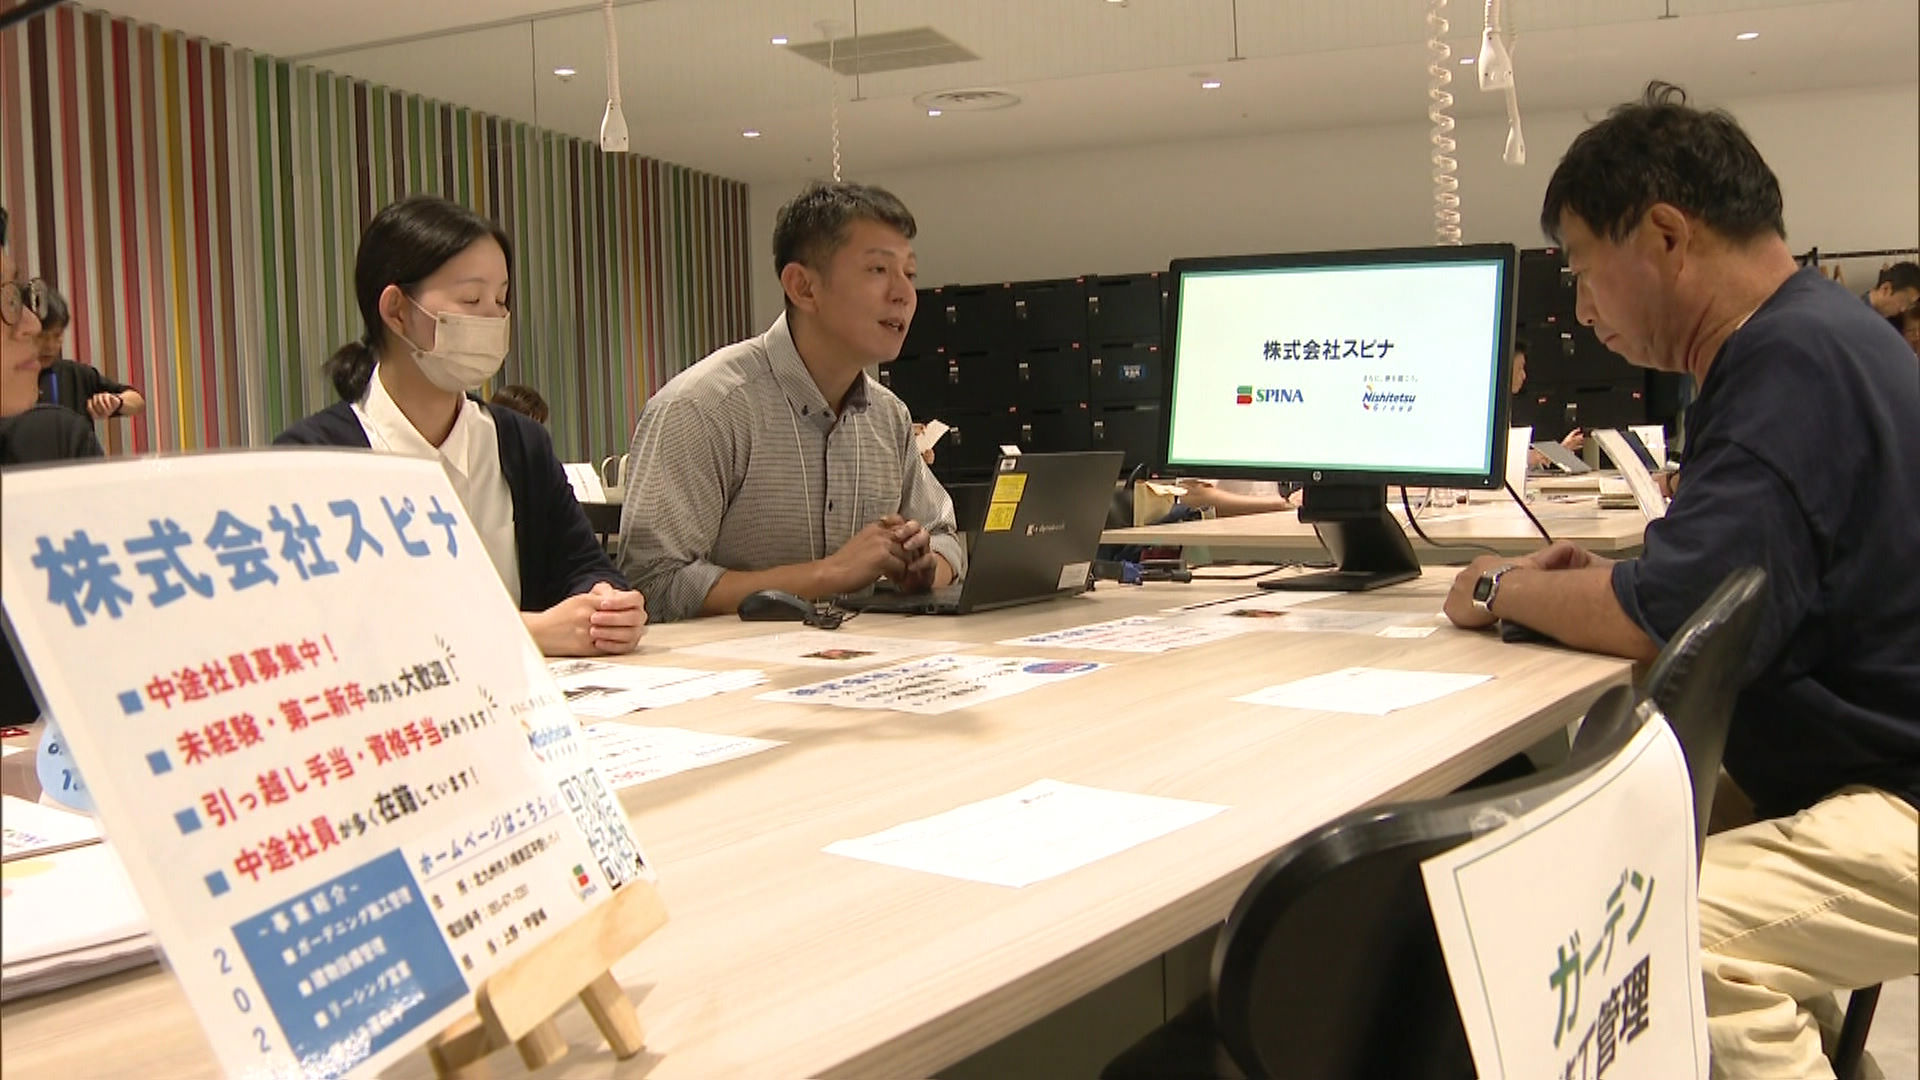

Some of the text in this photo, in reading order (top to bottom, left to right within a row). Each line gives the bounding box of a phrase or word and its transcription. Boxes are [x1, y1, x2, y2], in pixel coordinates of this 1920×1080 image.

[1264, 339, 1395, 361] 株式会社スピナ
[1256, 389, 1304, 403] SPINA
[1362, 391, 1416, 402] Nishitetsu
[30, 496, 458, 627] 株式会社スピナ
[146, 633, 339, 709] 中途社員募集中！
[1550, 867, 1655, 1049] ガーデン
